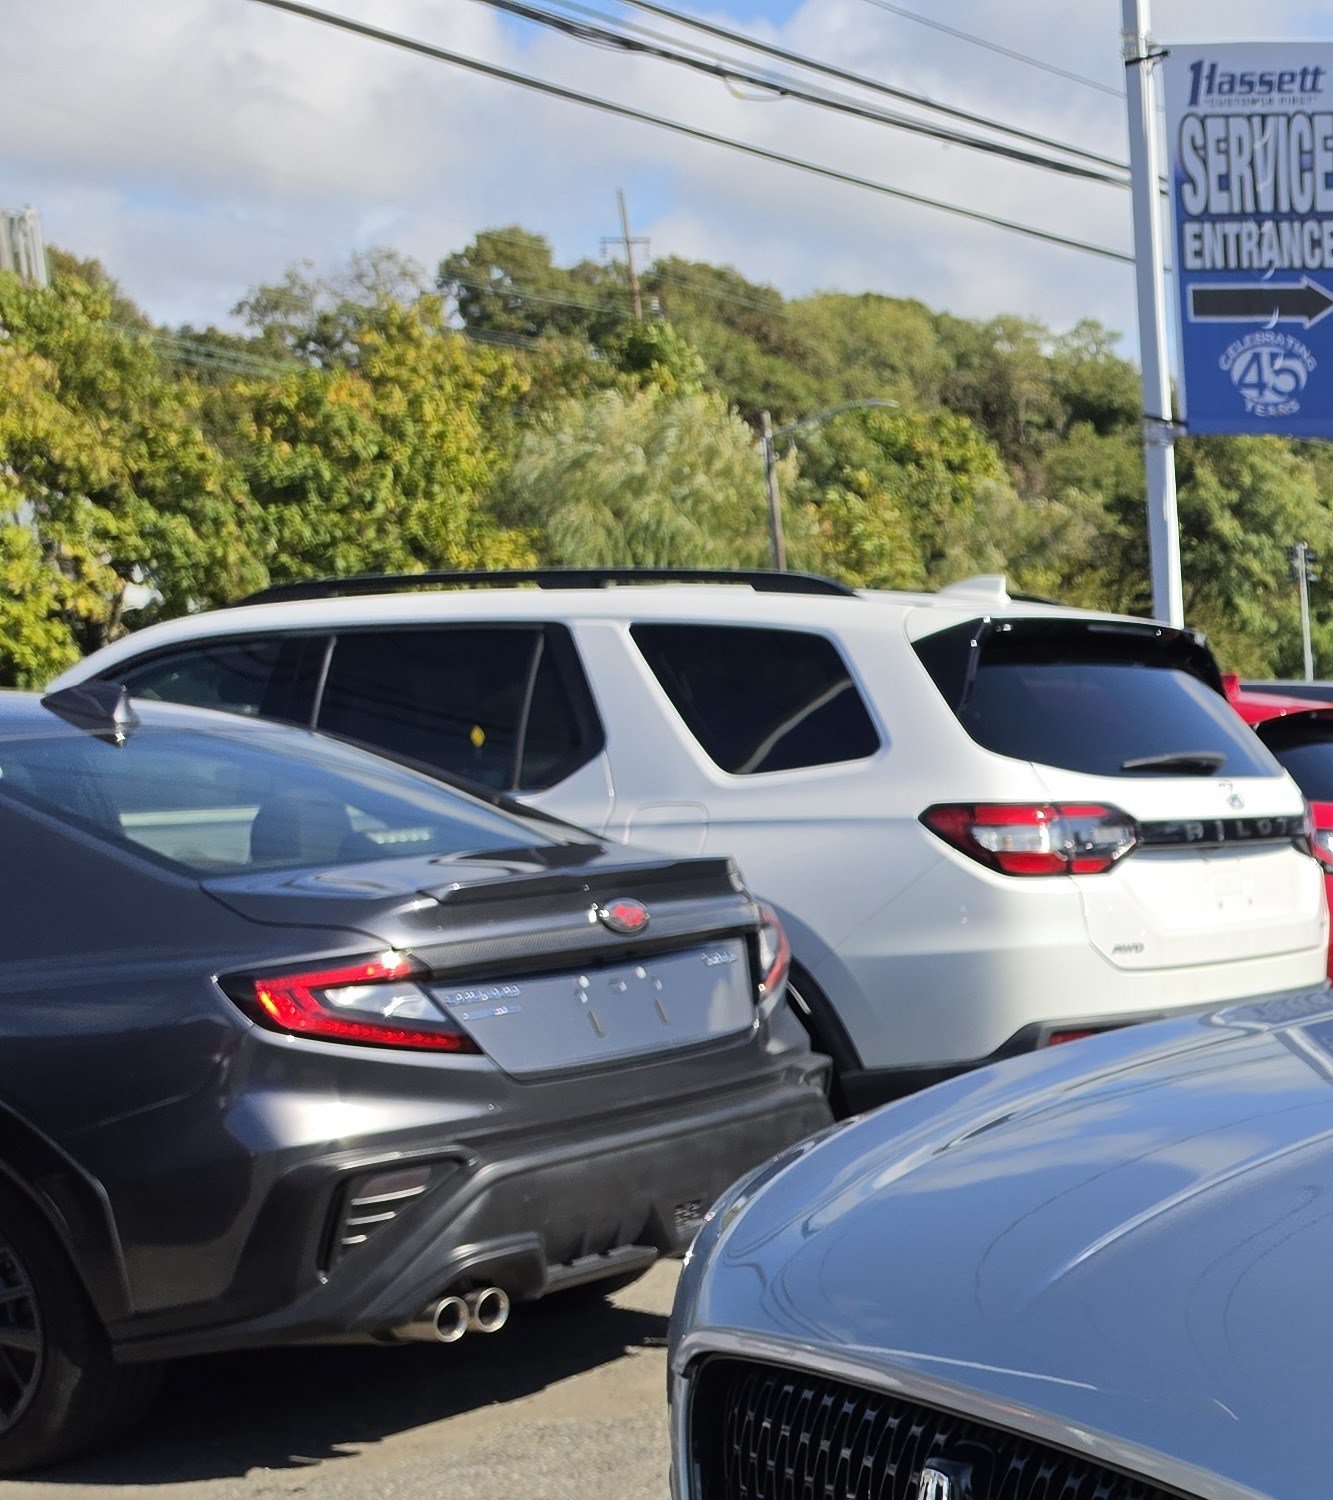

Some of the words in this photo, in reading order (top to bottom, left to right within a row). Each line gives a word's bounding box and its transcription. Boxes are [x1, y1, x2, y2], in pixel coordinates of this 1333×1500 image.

[1189, 60, 1327, 107] Hassett
[1218, 331, 1317, 372] CELEBRATING
[1238, 349, 1300, 396] 45
[1244, 398, 1300, 417] YEARS
